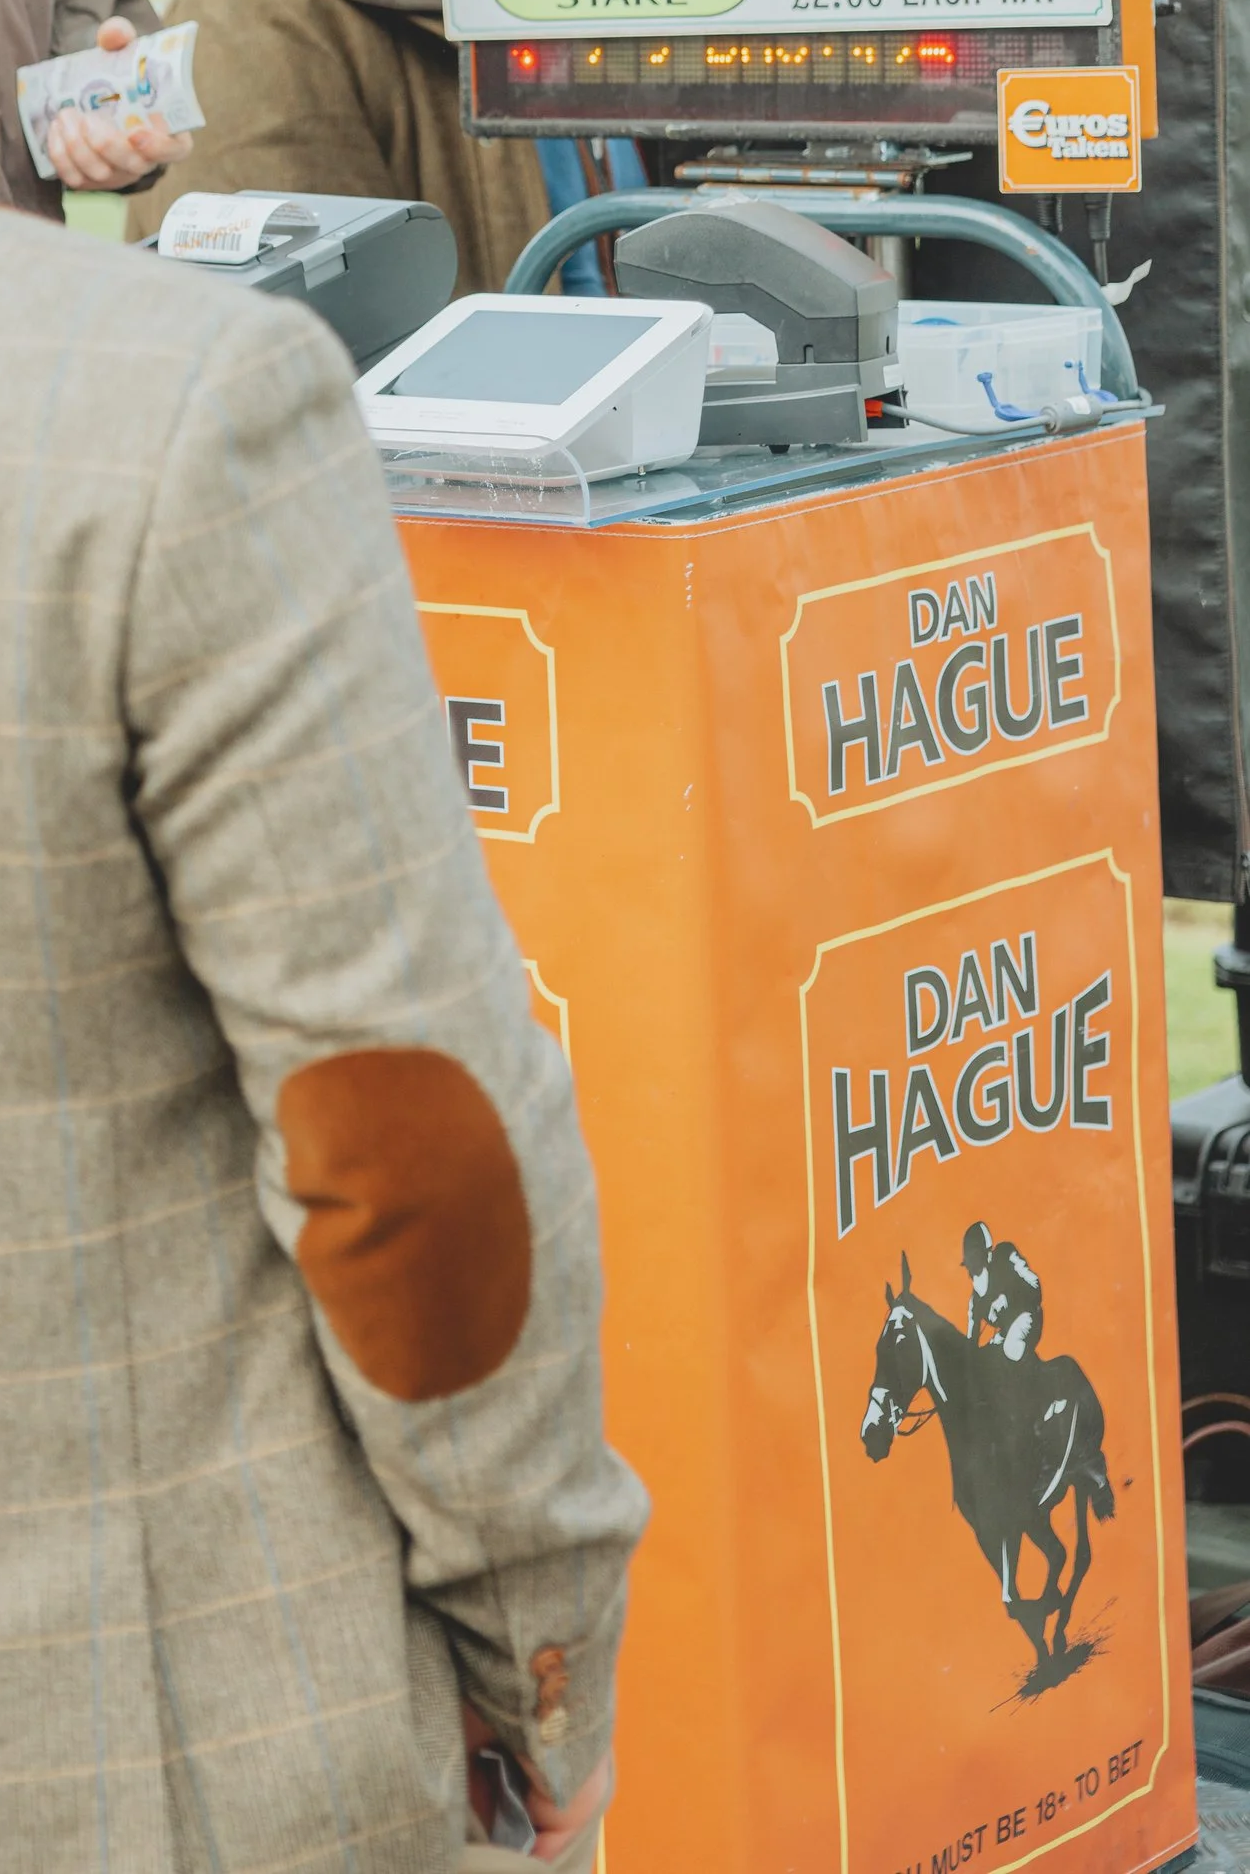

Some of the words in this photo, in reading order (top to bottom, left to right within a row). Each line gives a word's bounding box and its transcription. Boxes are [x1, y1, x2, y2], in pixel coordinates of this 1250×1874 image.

[1046, 135, 1130, 159] Taken
[909, 570, 998, 649] DAN
[821, 612, 1090, 798] HAGUE
[904, 931, 1038, 1059] DAN
[831, 969, 1113, 1240] HAGUE
[931, 1823, 989, 1874] MUST
[995, 1806, 1028, 1845] BE
[1034, 1790, 1067, 1826] 18+
[1074, 1767, 1100, 1802] TO
[1107, 1738, 1144, 1786] BET
